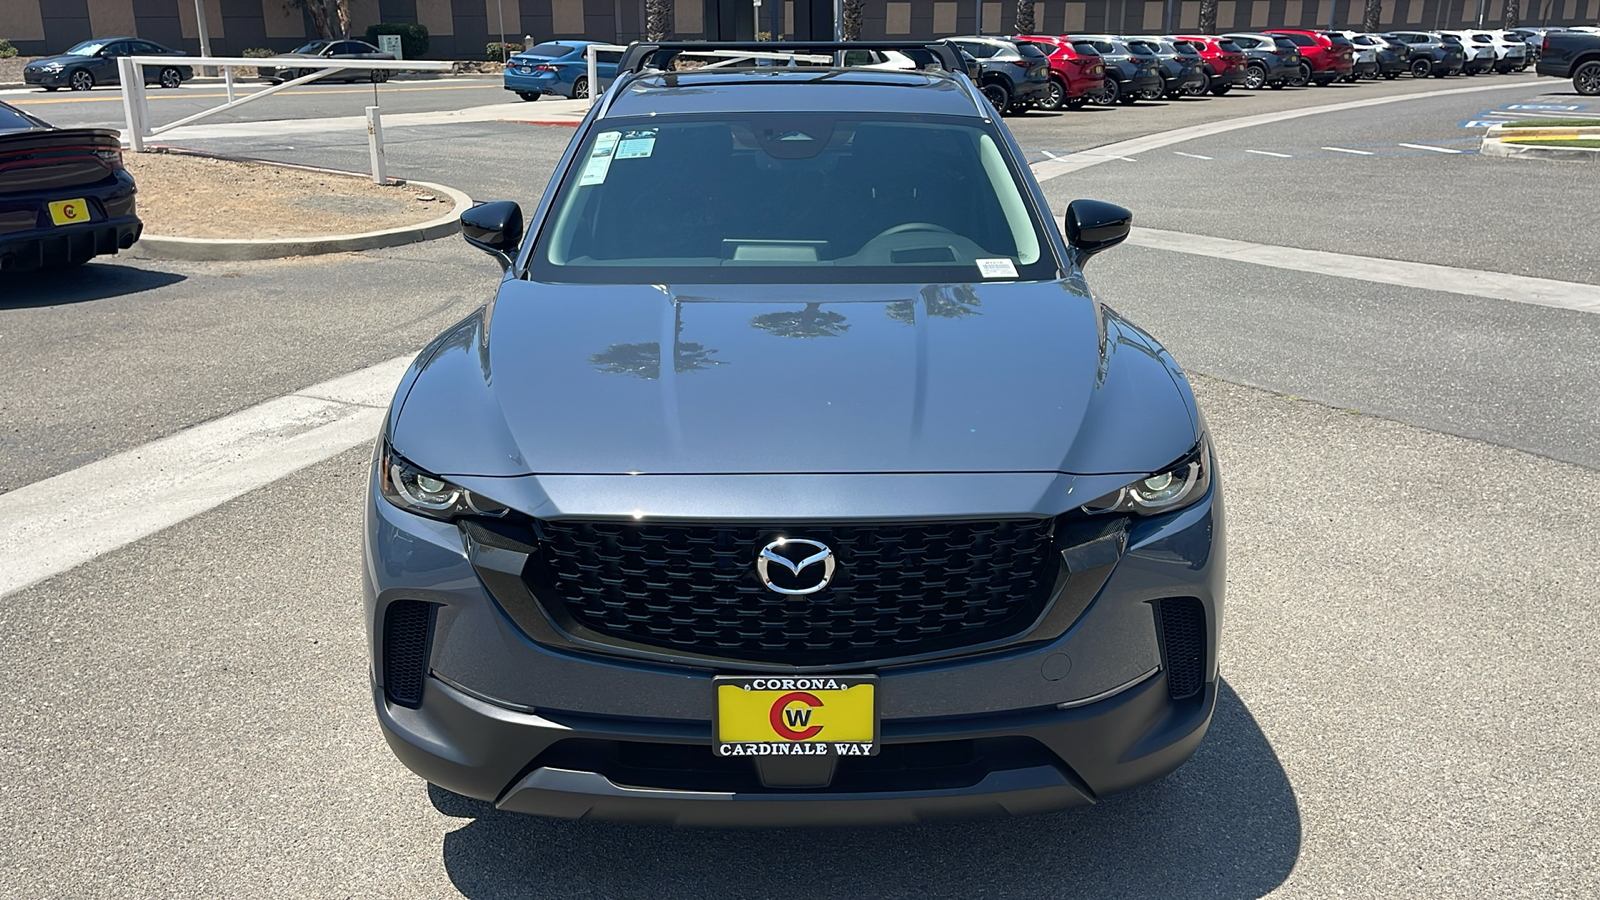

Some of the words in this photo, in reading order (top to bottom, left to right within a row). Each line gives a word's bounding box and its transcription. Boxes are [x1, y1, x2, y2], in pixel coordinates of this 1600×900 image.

[753, 679, 839, 690] CORONA
[720, 743, 827, 756] CARDINALE
[834, 743, 873, 756] WAY
